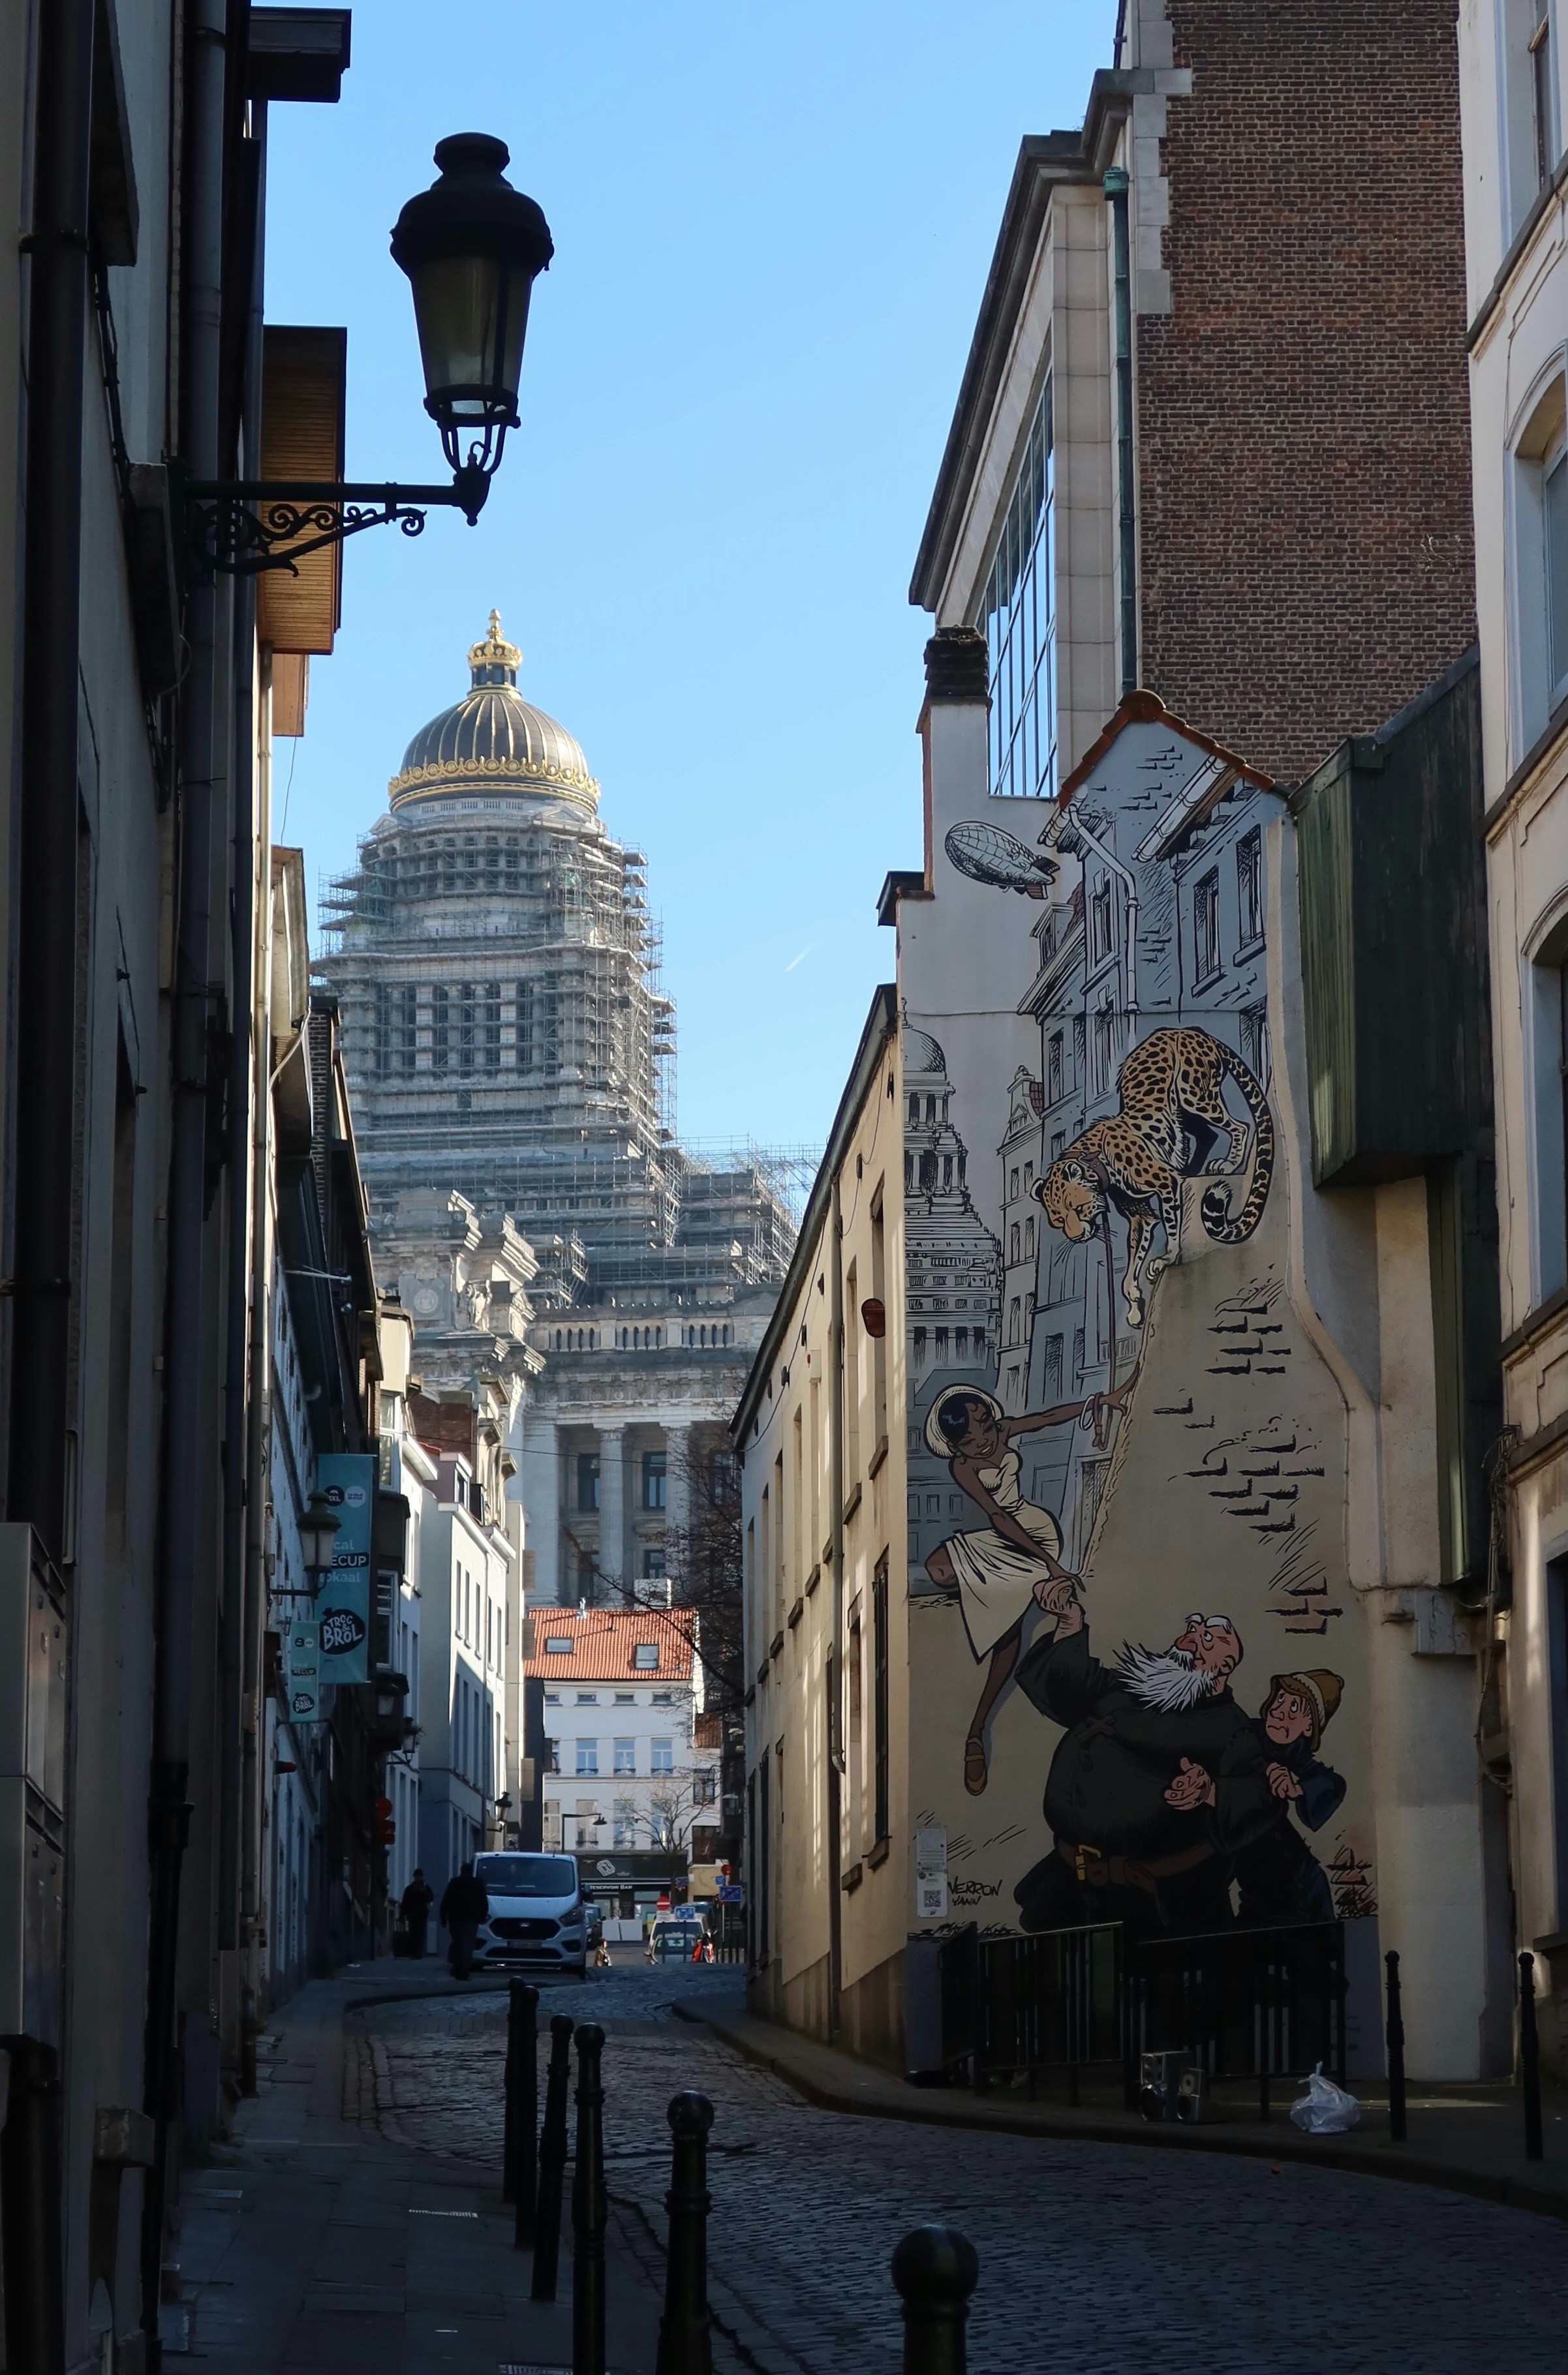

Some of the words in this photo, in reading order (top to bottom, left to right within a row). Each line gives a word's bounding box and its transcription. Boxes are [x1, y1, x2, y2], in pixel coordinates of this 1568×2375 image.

[330, 1555, 367, 1567] ECUP
[327, 1614, 354, 1628] TROC
[341, 1623, 350, 1632] &
[323, 1623, 363, 1651] BROL
[947, 1875, 1003, 1896] VERRON
[952, 1895, 982, 1907] YANN
